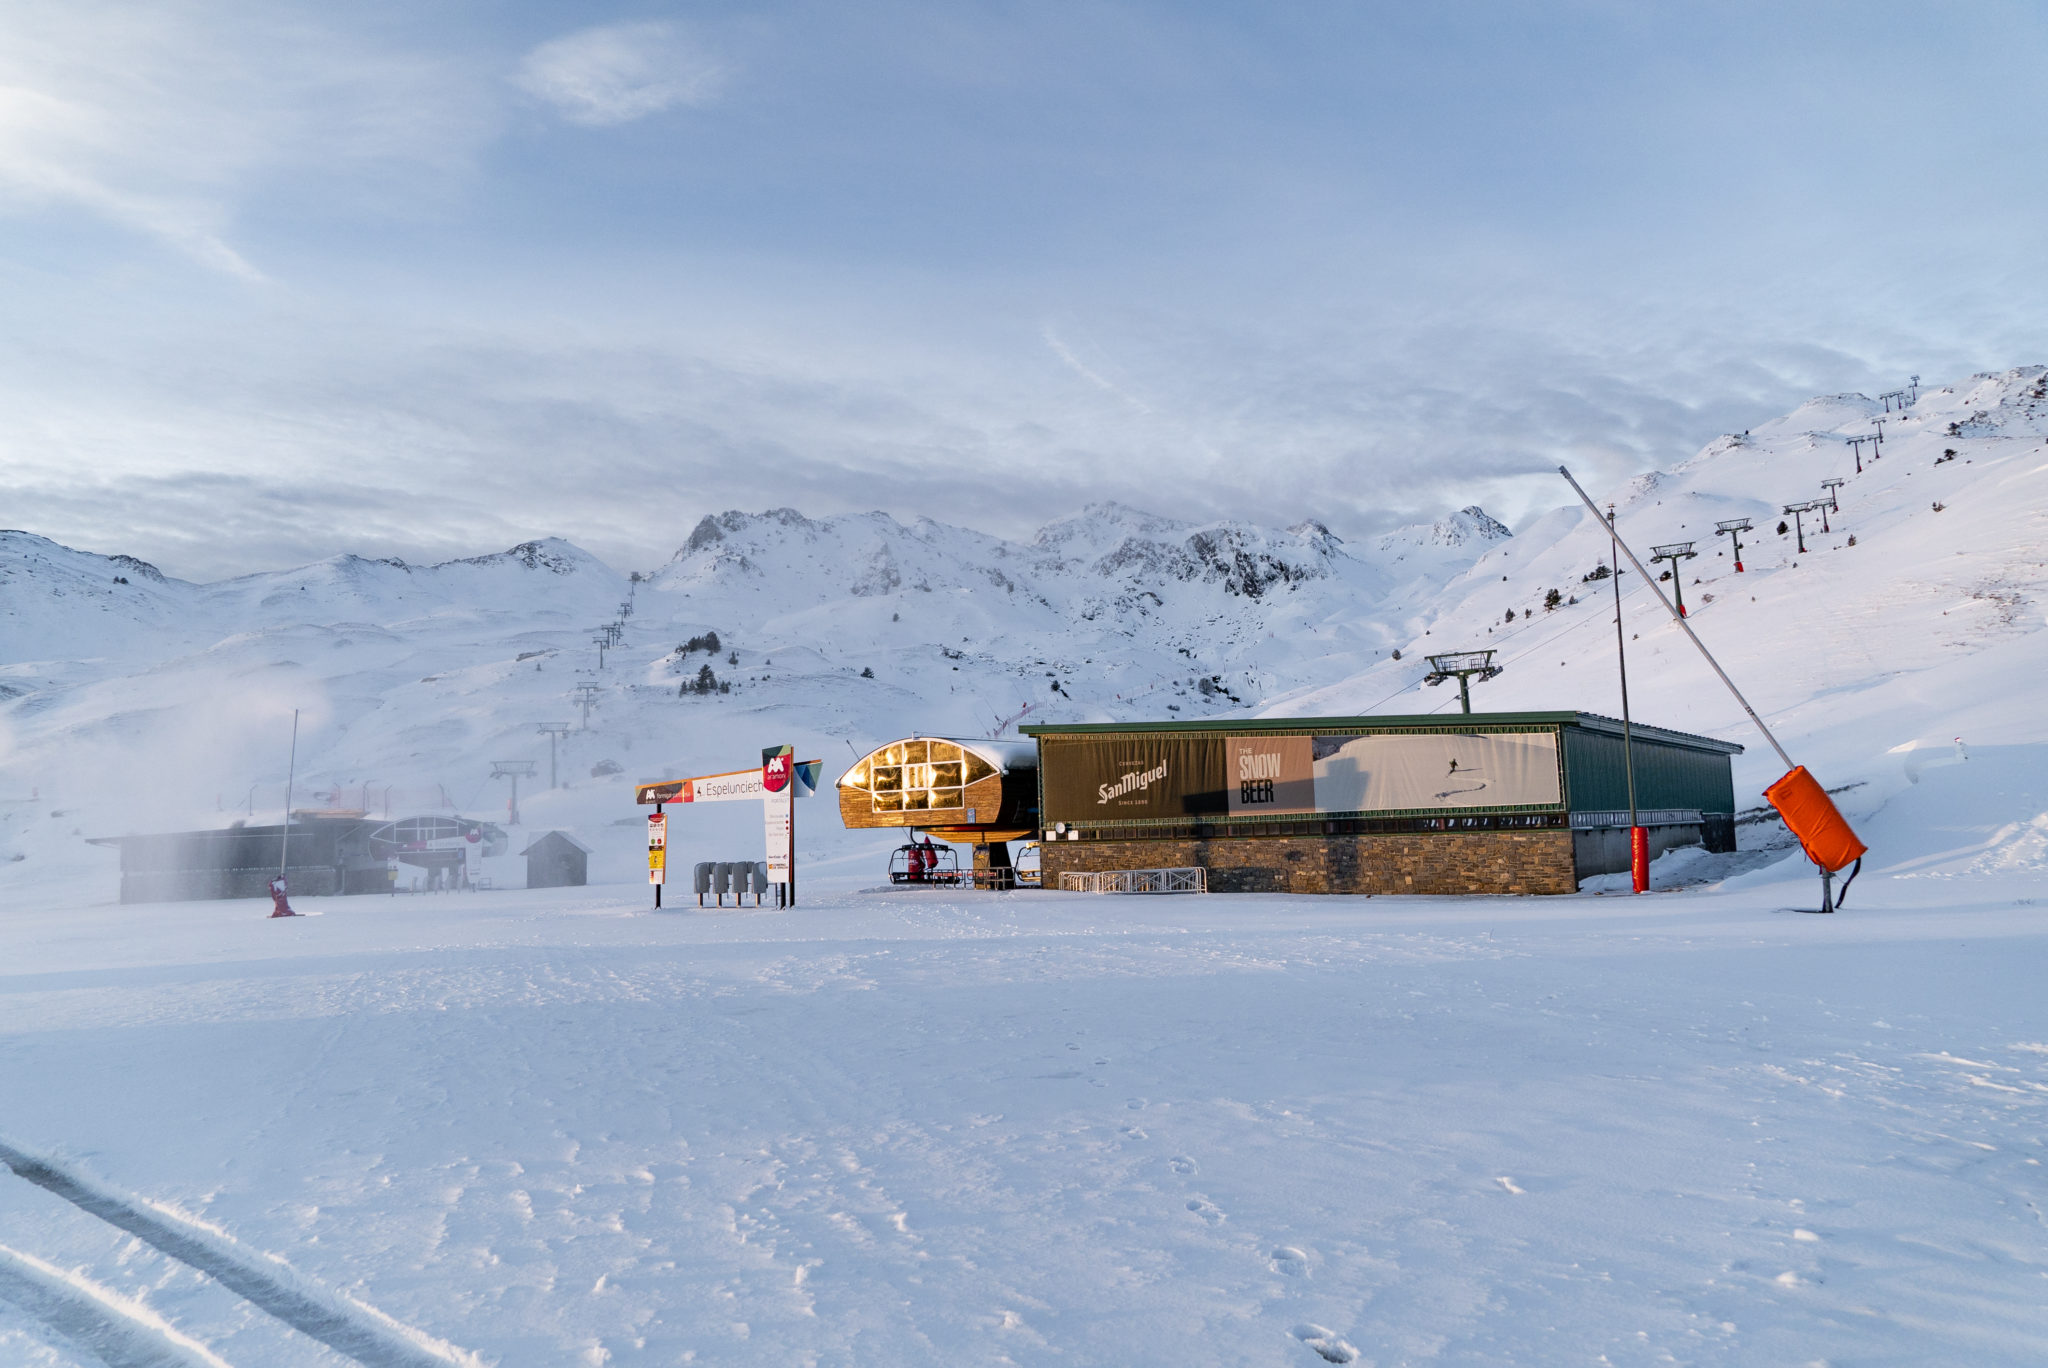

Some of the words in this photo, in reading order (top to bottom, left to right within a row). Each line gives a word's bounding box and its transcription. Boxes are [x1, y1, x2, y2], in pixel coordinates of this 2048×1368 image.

[1239, 752, 1281, 780] SNOW
[706, 779, 764, 798] Espelunciech
[1240, 779, 1275, 805] BEER
